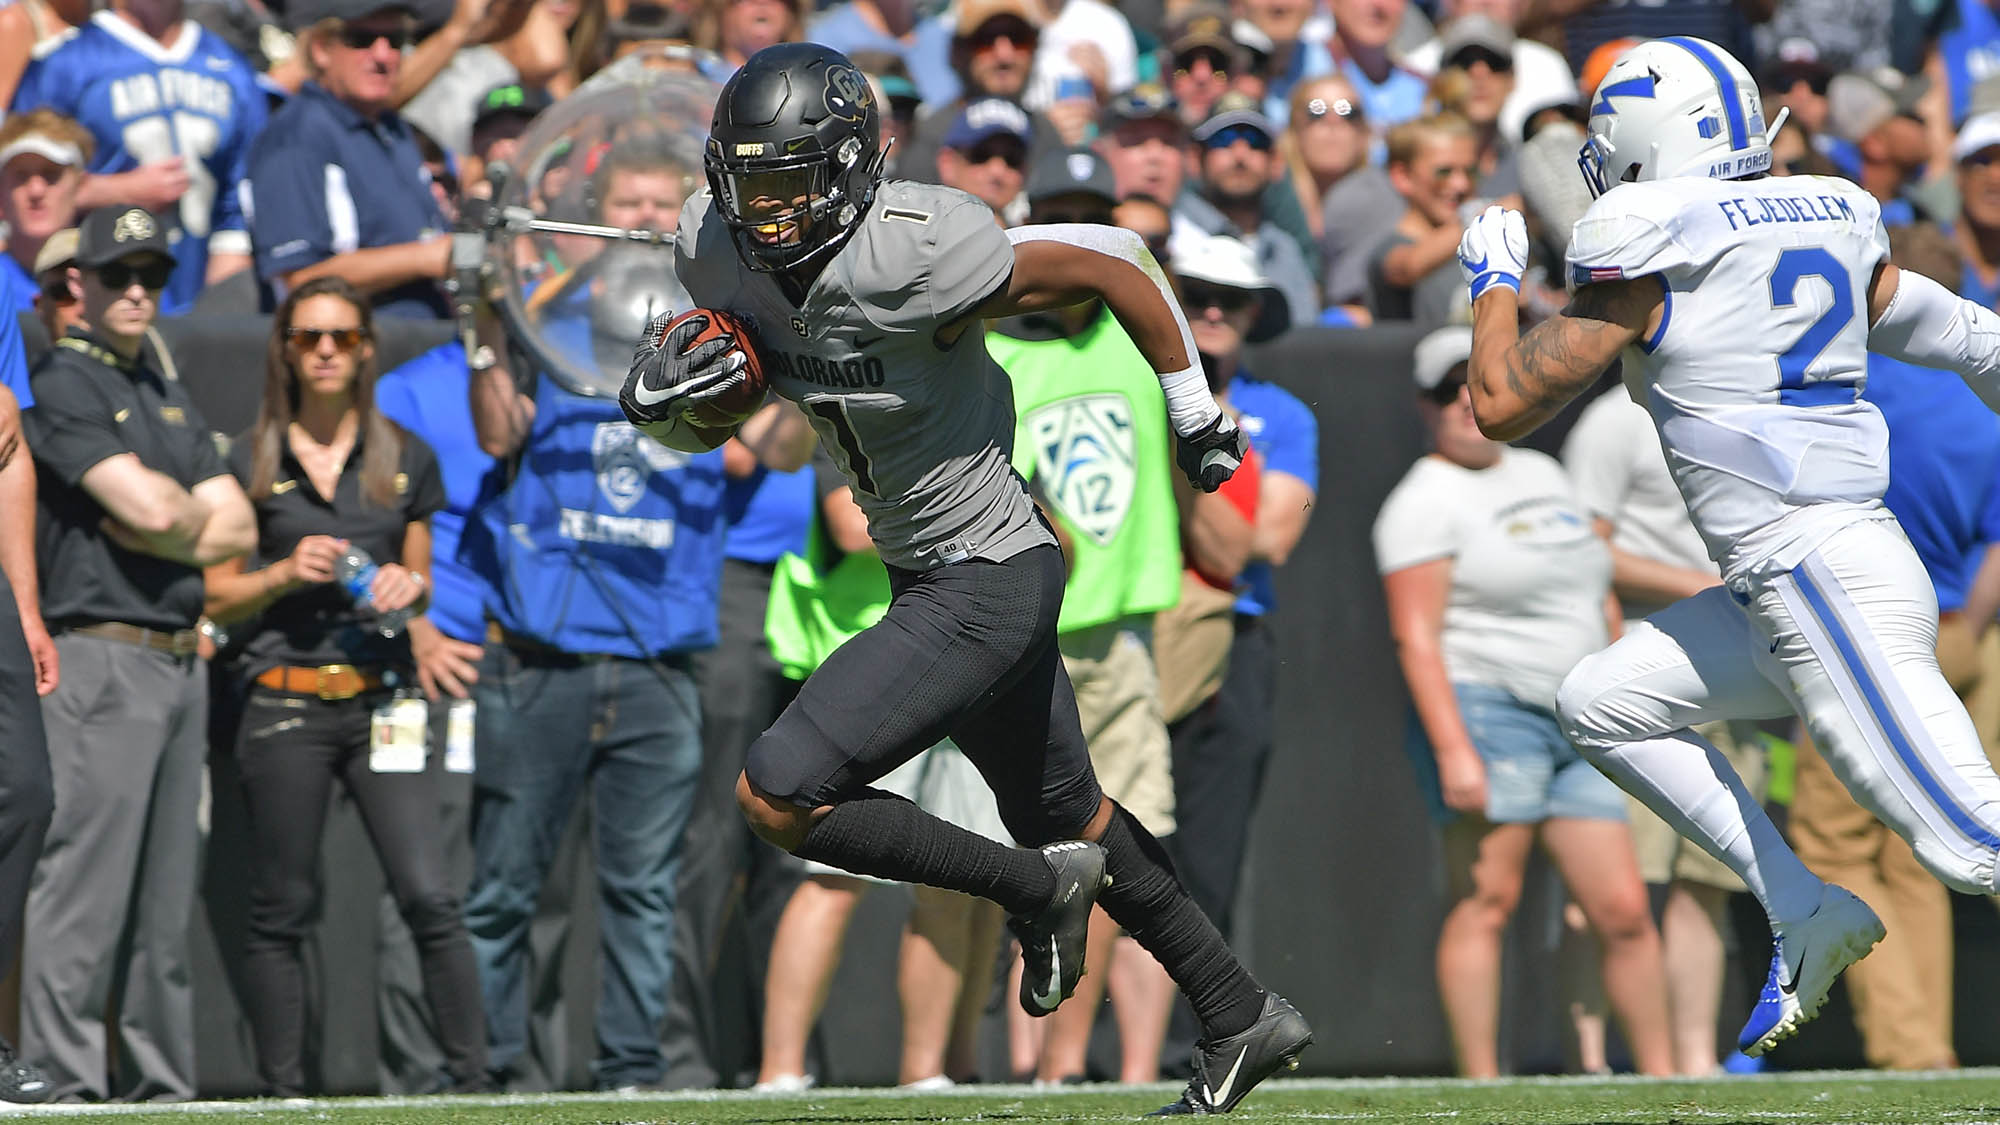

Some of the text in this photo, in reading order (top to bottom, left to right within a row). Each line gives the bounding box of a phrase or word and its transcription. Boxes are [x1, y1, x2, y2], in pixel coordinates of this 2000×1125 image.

[1748, 93, 1759, 114] 2
[736, 143, 764, 157] BUFFS
[1708, 152, 1769, 177] AIR FORCE
[881, 205, 933, 226] 1
[1718, 195, 1857, 231] FEJEDELEM
[1767, 245, 1857, 407] 2
[767, 350, 886, 388] OLORADO
[807, 396, 880, 498] 1
[1075, 471, 1116, 516] 12
[943, 542, 957, 554] 40
